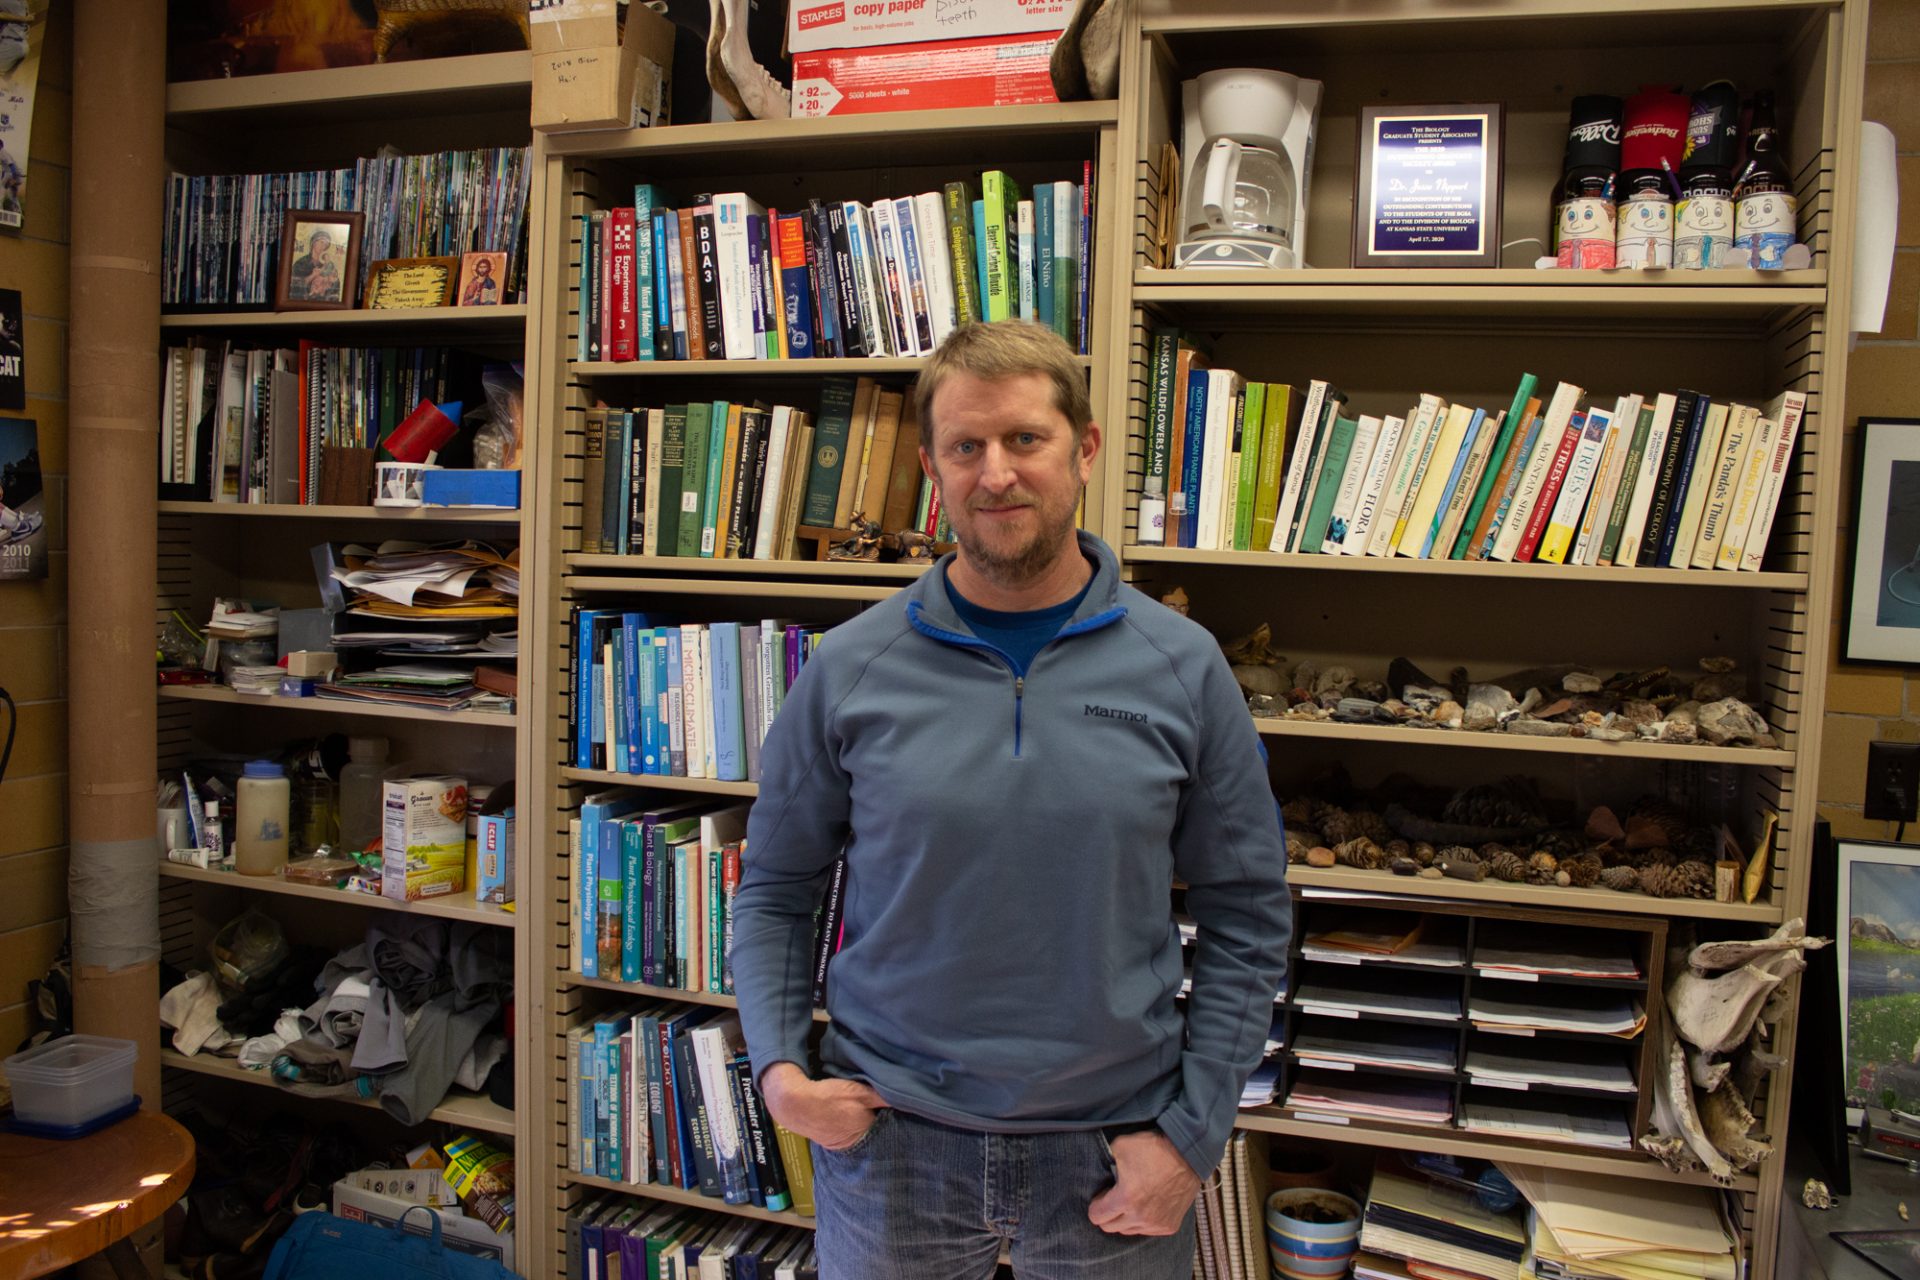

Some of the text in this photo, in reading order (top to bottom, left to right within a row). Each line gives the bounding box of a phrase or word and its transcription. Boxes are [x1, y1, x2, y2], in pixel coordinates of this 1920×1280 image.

[800, 7, 844, 25] STAPLES
[854, 3, 885, 17] copy
[888, 0, 926, 15] paper
[936, 8, 978, 27] teeth
[1026, 7, 1046, 15] letter
[806, 86, 820, 97] 92
[806, 99, 819, 111] 20
[849, 87, 910, 100] 5000 sheets white
[614, 241, 631, 250] Kirk
[805, 240, 813, 263] FIRE
[904, 229, 914, 252] Ecology
[928, 239, 937, 258] Time
[1042, 247, 1050, 258] El
[1408, 236, 1422, 244] April
[614, 255, 622, 285] Design
[882, 230, 898, 292] Grassland Dynamics
[952, 225, 968, 313] Ecological Models and Data
[987, 224, 1001, 296] Elevated Carbon Dioxide
[1042, 260, 1051, 288] Niño
[402, 288, 429, 296] Government
[620, 254, 630, 312] Experimental
[642, 285, 650, 308] Mixed
[684, 235, 700, 339] Elementary Statistical Methods
[842, 252, 851, 278] Structure
[847, 288, 855, 312] Function
[840, 281, 852, 329] Desert Ecosystem
[618, 318, 626, 330] 3
[1154, 334, 1170, 475] KANSAS WILDFLOWERS AND
[1736, 408, 1748, 430] GOULD
[1288, 385, 1322, 495] Wildflowers and Grasses Kansas
[1644, 429, 1659, 462] OF ECOLOGY
[1760, 423, 1770, 445] BRENT
[1780, 411, 1796, 443] Almost
[755, 439, 767, 478] Prairie Plants
[1187, 385, 1203, 515] NORTH AMERICAN RANGE PLANTS
[1354, 439, 1368, 465] PLANT
[1394, 419, 1428, 498] Grass Systematics
[1412, 415, 1443, 489] HOW TO IDENTIFY PLANTS
[1549, 447, 1570, 483] TREES
[1646, 430, 1665, 477] THE BACKGROUND
[1771, 441, 1789, 475] Human
[732, 417, 752, 532] GRASSLANDS GREAT PLAINS
[1343, 464, 1360, 501] SCIENCES
[1355, 419, 1401, 537] ROCKY MOUNTAIN FLORA
[1450, 450, 1480, 512] Western Forest Trees
[1522, 440, 1552, 500] MOUNTAIN
[1568, 443, 1596, 498] TREES
[1618, 449, 1640, 509] Field Guide Common
[1647, 417, 1685, 545] THE PHILOSOPHY OF ECOLOGY
[1703, 430, 1743, 543] The Panda's Thumb
[1734, 447, 1766, 528] Charles Darwin
[762, 465, 779, 515] Ecology
[1509, 498, 1529, 532] SHEEP
[2, 544, 31, 557] 2010
[2, 557, 31, 569] 2011
[682, 648, 697, 748] MICROCLIMATE
[764, 641, 773, 722] Forgotten Grasslands of
[568, 692, 576, 725] Geochemistry
[1083, 703, 1149, 725] Marmot
[488, 829, 496, 850] CLIF
[644, 850, 654, 887] Biology
[584, 875, 592, 922] Physiology
[626, 855, 636, 952] Plant Physiological Ecology
[726, 880, 734, 919] Physiological
[816, 859, 843, 984] INTRODUCTION TO PLANT PHYSIOLOGY
[660, 1028, 672, 1088] ECOLOGY
[611, 1103, 617, 1111] OF
[639, 1073, 647, 1123] DIVERSITY
[650, 1080, 661, 1115] ECOLOGY
[610, 1112, 619, 1149] DENDROLOGY
[691, 1117, 702, 1149] ECOLOGY
[698, 1104, 712, 1160] PHYSIOLOGICAL
[741, 1075, 768, 1167] Freshwater Ecology
